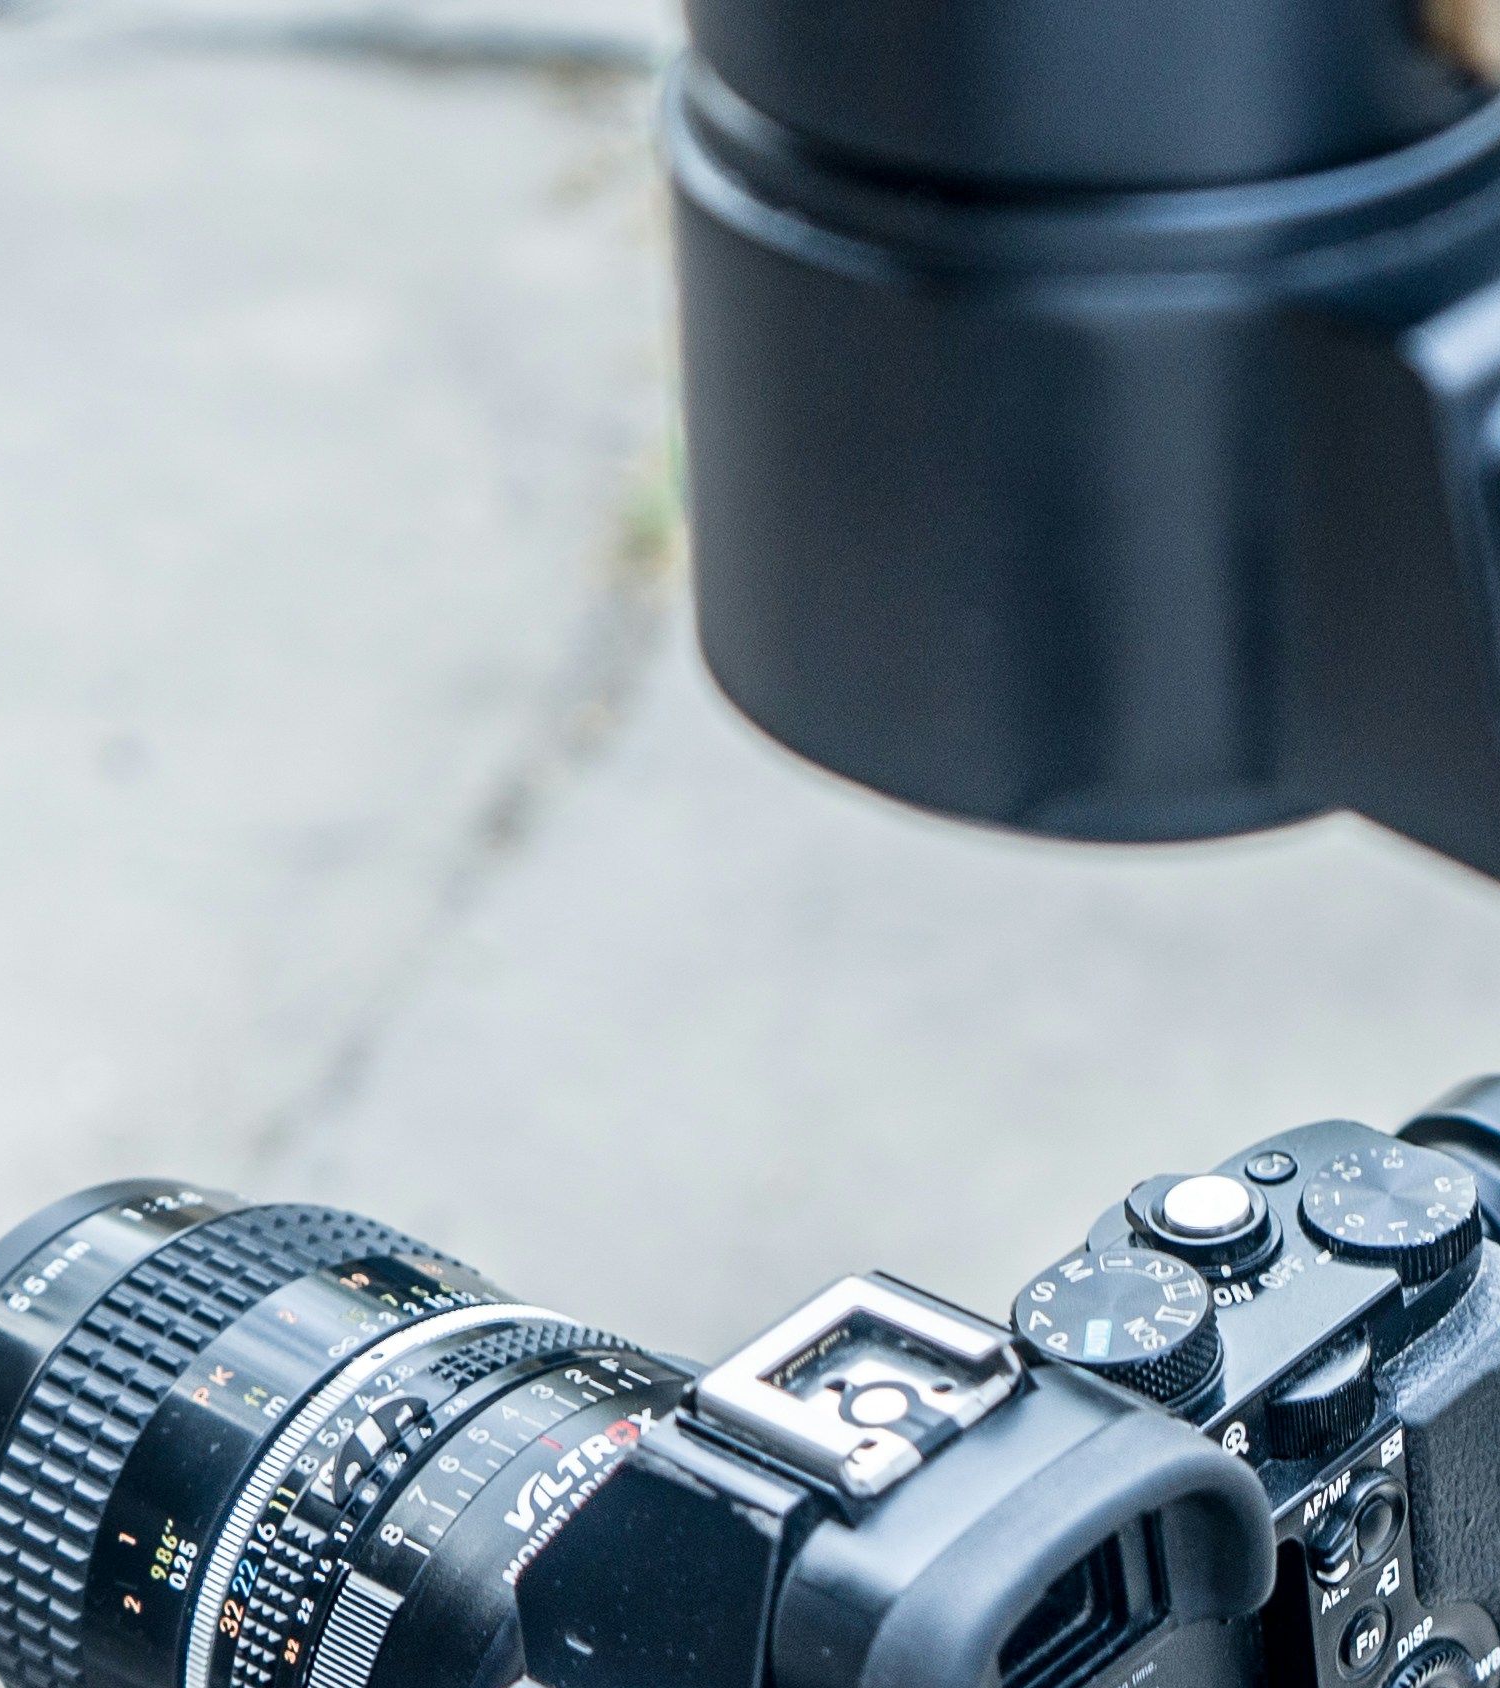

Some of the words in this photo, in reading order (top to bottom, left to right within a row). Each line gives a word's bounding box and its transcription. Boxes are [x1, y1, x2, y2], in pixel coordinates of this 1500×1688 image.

[8, 1239, 92, 1313] 55mm
[1029, 1280, 1057, 1303] S
[1058, 1258, 1094, 1283] M
[1212, 1280, 1254, 1307] ON
[1028, 1309, 1053, 1332] A
[1045, 1331, 1070, 1353] P
[379, 1522, 404, 1547] 8
[406, 1483, 429, 1507] 7
[437, 1454, 461, 1475] 6
[466, 1425, 491, 1446] 5
[501, 1404, 520, 1422] 4
[529, 1383, 555, 1400] 3
[564, 1367, 591, 1385] 2
[503, 1407, 660, 1533] VILTROX
[1302, 1471, 1352, 1526] AF/MF
[219, 1599, 245, 1639] 32
[232, 1558, 260, 1599] 22
[247, 1522, 277, 1556] 16
[267, 1486, 298, 1514] 11
[296, 1453, 320, 1477] 8
[501, 1503, 572, 1587] MOUNT
[283, 1637, 301, 1666] 32
[296, 1596, 316, 1626] 22
[312, 1557, 333, 1583] 16
[1355, 1627, 1381, 1660] Fn
[1397, 1615, 1433, 1662] DISP
